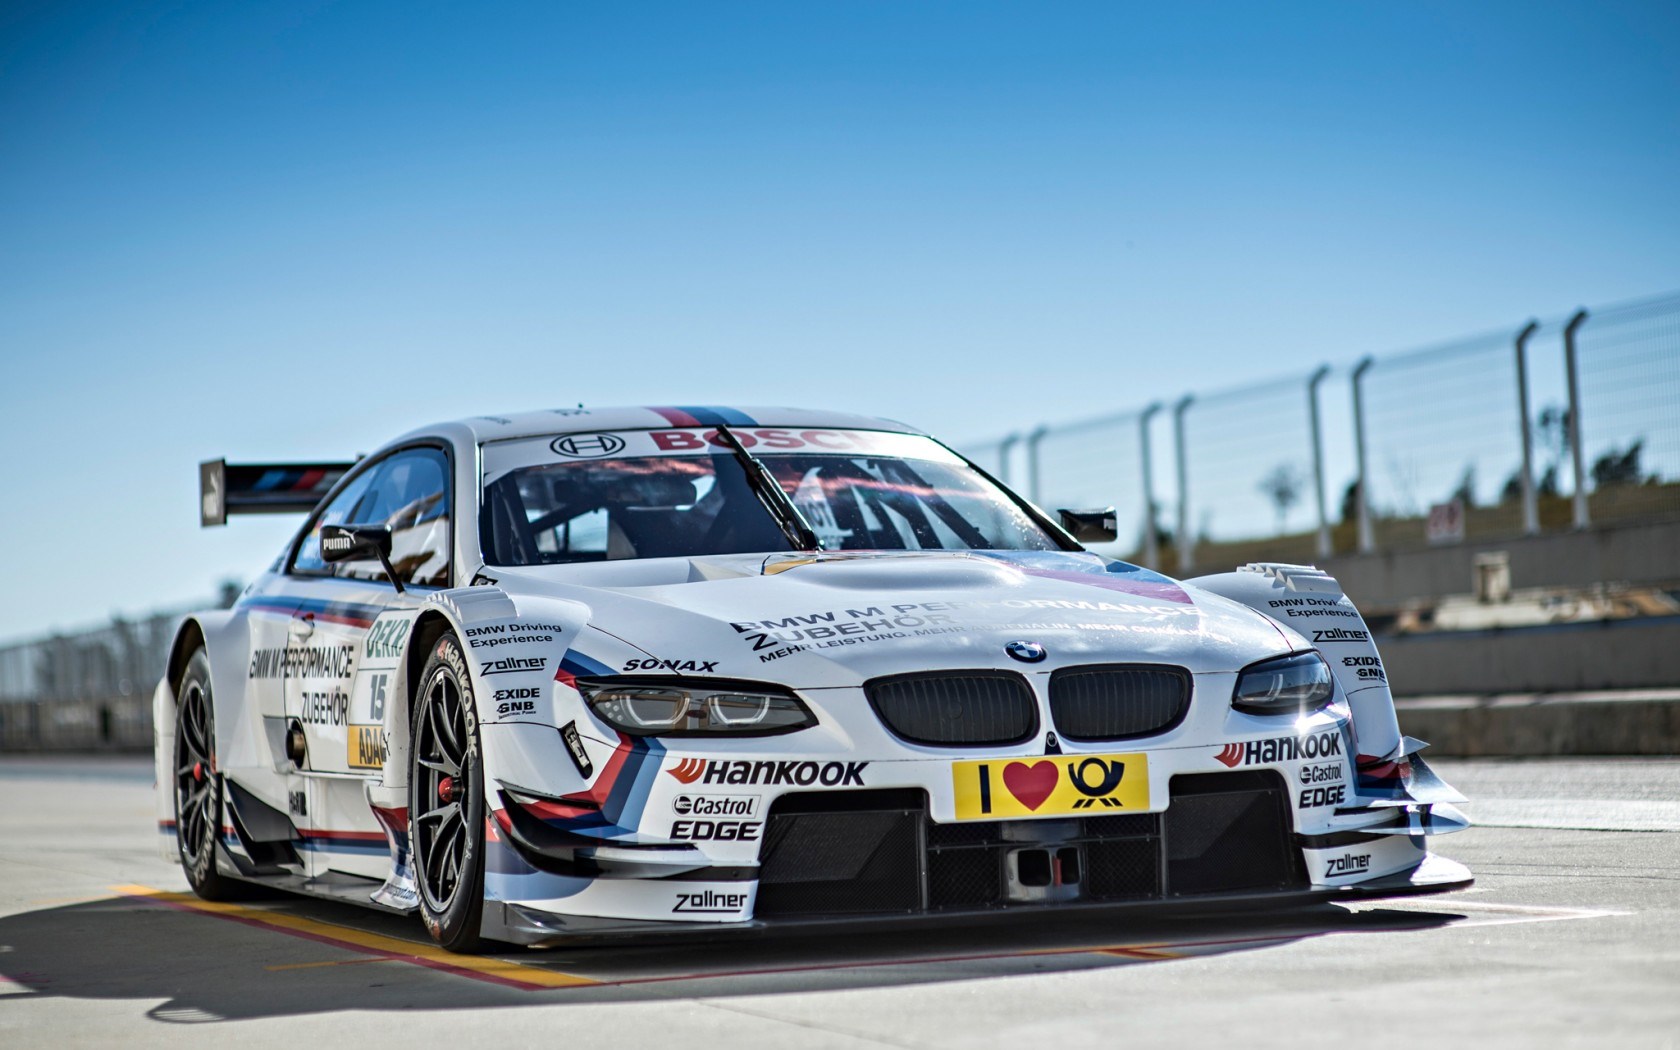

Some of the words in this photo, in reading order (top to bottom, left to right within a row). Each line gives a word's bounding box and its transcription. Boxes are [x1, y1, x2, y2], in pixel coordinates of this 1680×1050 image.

[323, 538, 350, 550] PUMA
[1268, 598, 1304, 608] BMW
[1286, 607, 1359, 619] Experience
[465, 624, 505, 637] BMW
[509, 622, 562, 634] Driving
[730, 612, 836, 634] BMW
[845, 606, 885, 619] M
[366, 619, 411, 658] DEKR
[470, 634, 553, 648] Experience
[745, 613, 959, 652] ZUBEHÖR
[1312, 628, 1369, 643] zollner
[759, 643, 812, 663] MEHR
[816, 630, 912, 649] LEISTUNG.
[914, 626, 968, 636] MEHR
[250, 649, 271, 680] BMW
[269, 649, 279, 678] M
[278, 645, 354, 680] PERFORMANCE
[480, 657, 548, 677] zollner
[623, 658, 720, 673] SONAX
[1342, 656, 1381, 668] EXIDE
[1356, 668, 1386, 679] GNB
[370, 674, 388, 721] 15
[493, 687, 541, 702] EXIDE
[302, 685, 349, 727] ZUBEHÖR
[497, 701, 534, 714] GNB
[1312, 763, 1342, 783] Castrol
[978, 764, 992, 814] I
[1299, 784, 1347, 809] EDGE
[692, 797, 753, 815] Castrol
[670, 820, 763, 841] EDGE
[1325, 854, 1371, 878] zollner
[672, 890, 748, 913] zollner
